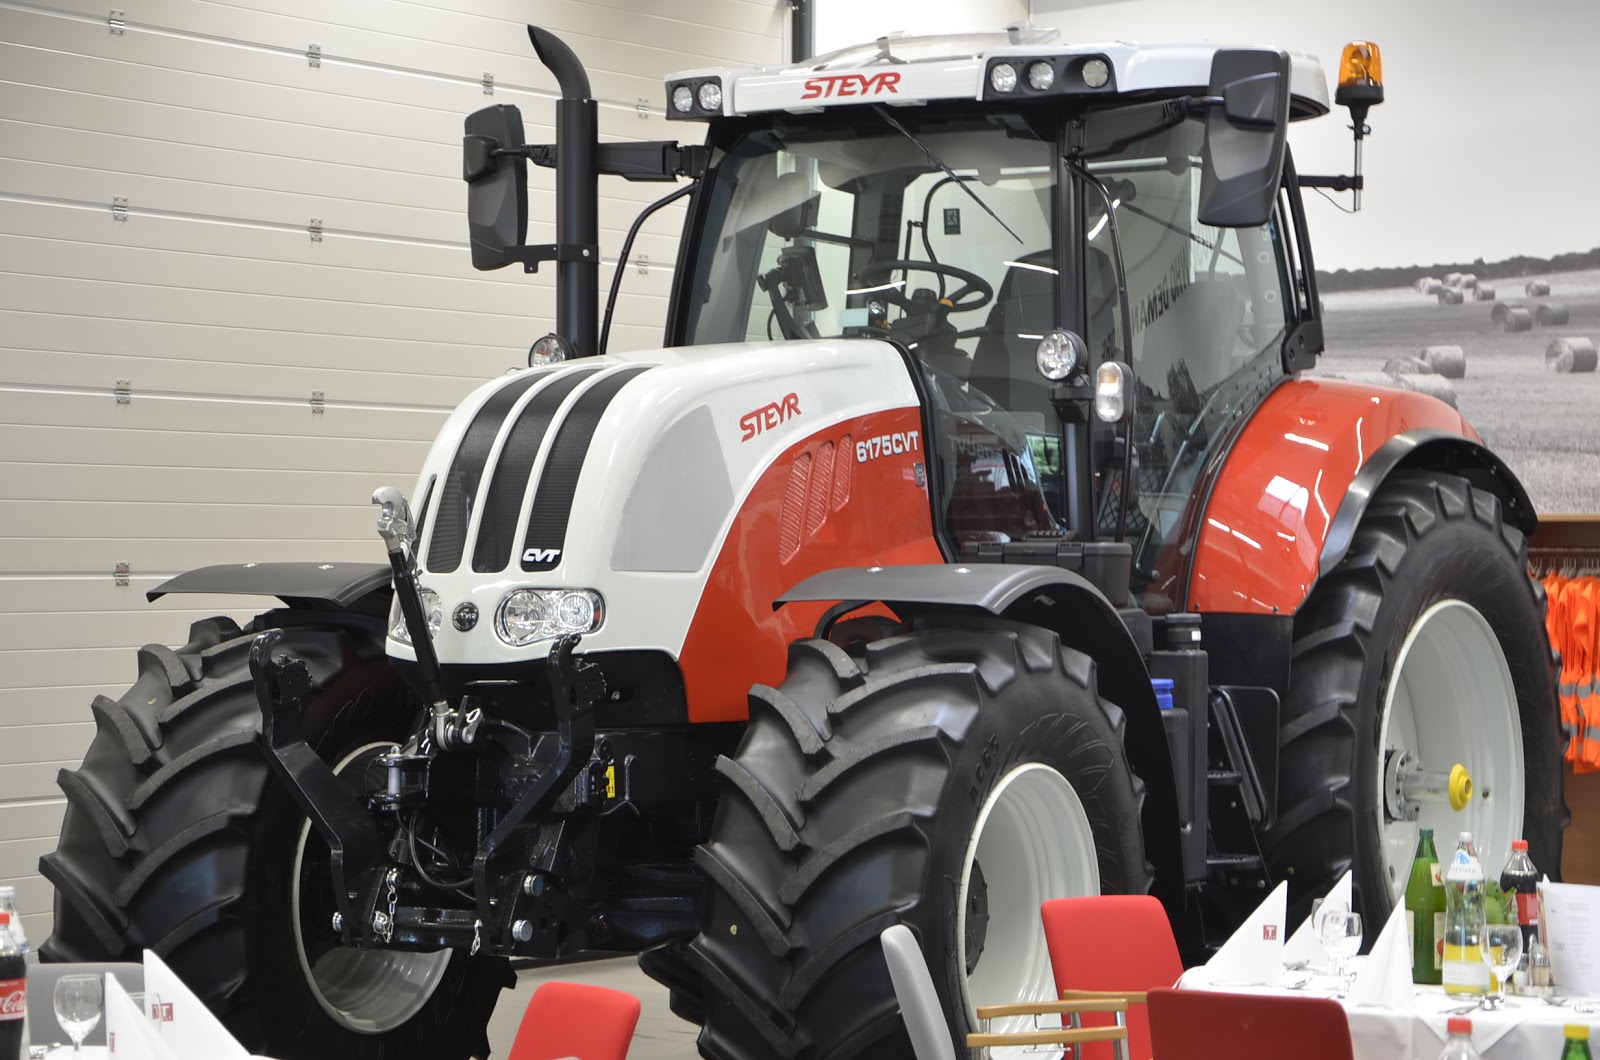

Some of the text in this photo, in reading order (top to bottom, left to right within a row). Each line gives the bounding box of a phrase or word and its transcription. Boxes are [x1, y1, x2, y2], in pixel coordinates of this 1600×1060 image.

[800, 72, 901, 99] STEYR
[739, 392, 802, 443] STEYR
[855, 430, 919, 464] 6175CVT
[522, 548, 561, 562] CVT
